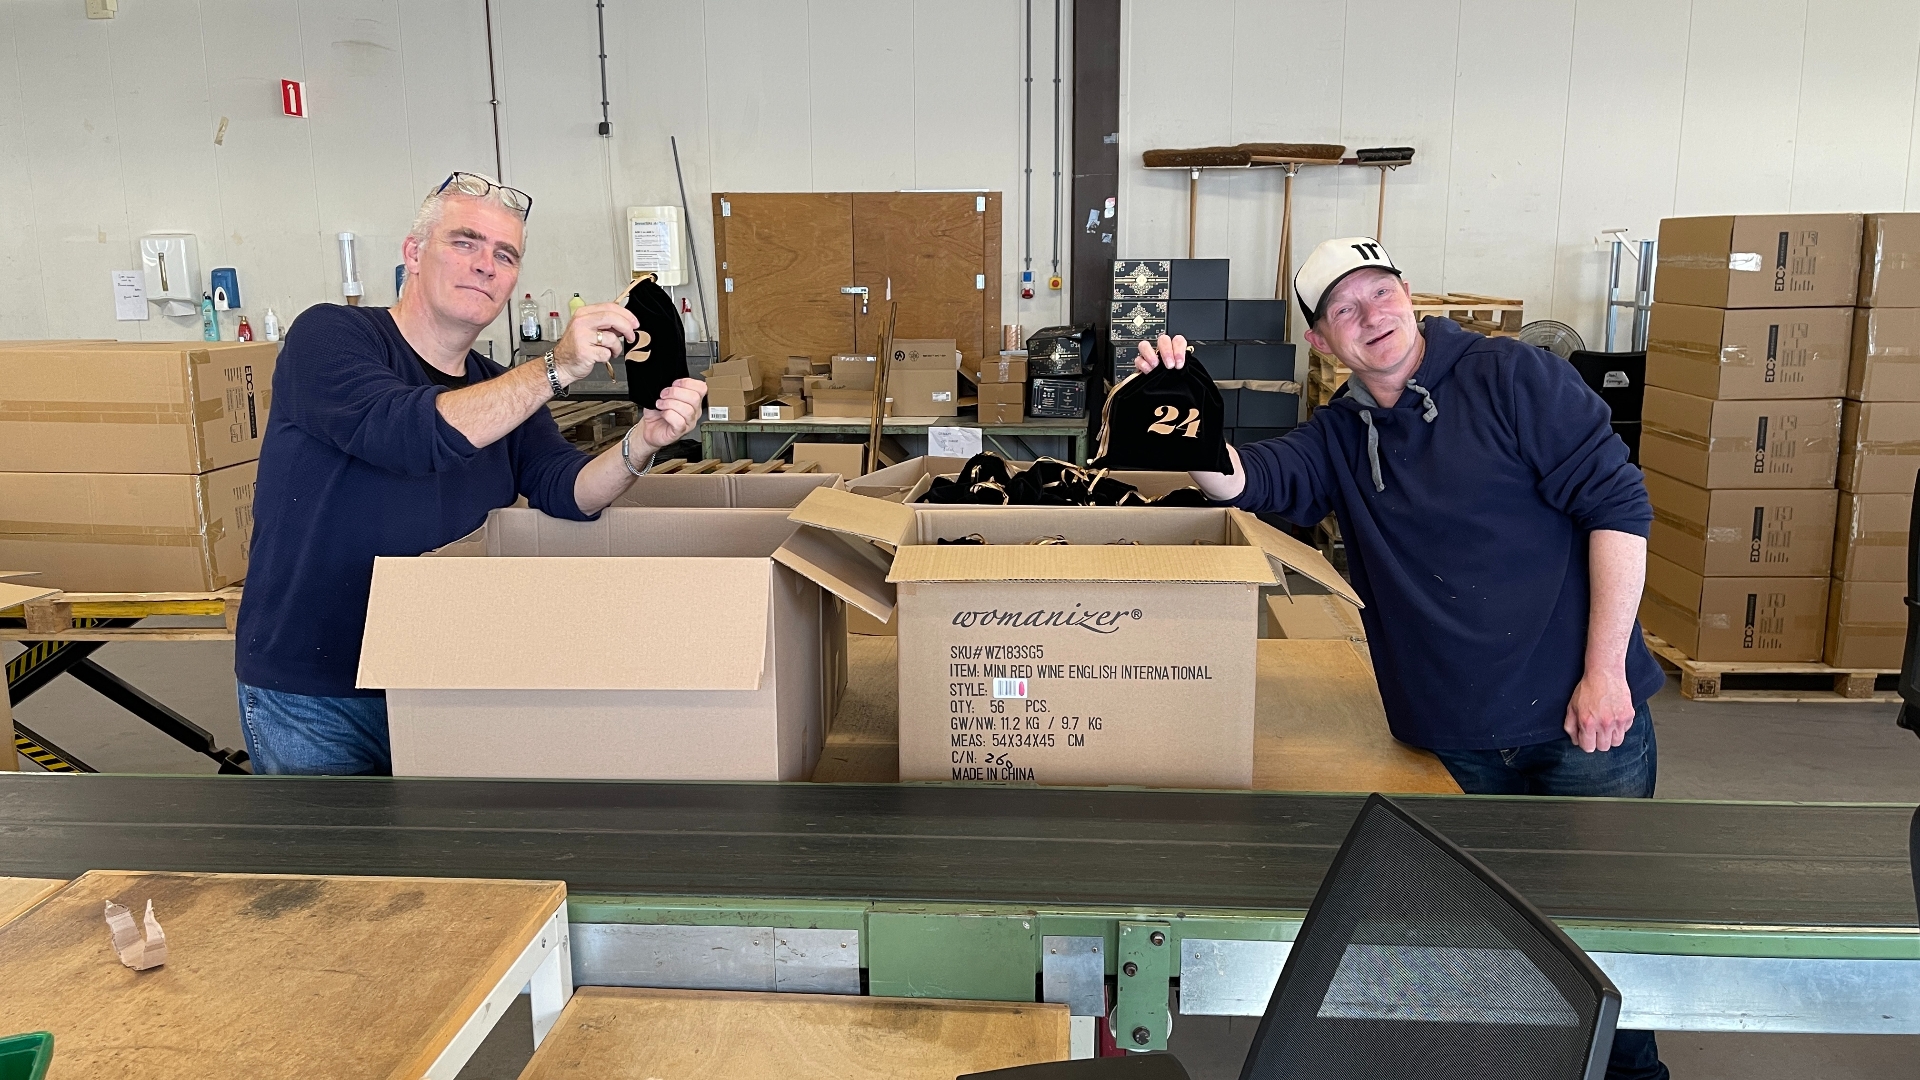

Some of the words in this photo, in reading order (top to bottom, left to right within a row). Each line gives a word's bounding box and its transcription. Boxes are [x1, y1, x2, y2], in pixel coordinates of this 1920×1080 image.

[1774, 270, 1785, 291] EDC
[245, 366, 254, 391] EDC
[1765, 362, 1775, 382] EDC
[1147, 405, 1200, 438] 24
[1754, 454, 1764, 473] EDC
[1750, 541, 1761, 562] EDC
[1743, 627, 1754, 649] EDC
[949, 663, 980, 677] ITEM:
[983, 663, 1007, 678] MINI
[1010, 664, 1033, 678] RED
[1037, 664, 1065, 679] WINE
[1068, 664, 1118, 679] ENGLISH
[1121, 664, 1213, 680] INTERNATIONAL
[949, 682, 988, 697] STYLE:
[950, 700, 975, 713] QTY:
[989, 699, 1005, 714] 56
[1025, 699, 1051, 713] PCS.
[950, 716, 996, 730] GW/NW:
[1000, 716, 1021, 730] 11.2
[1025, 716, 1040, 730] KG
[1061, 716, 1080, 730] 9.7
[1088, 716, 1103, 730] KG
[951, 733, 986, 747] MEAS:
[992, 733, 1055, 748] 54X34X45
[1067, 733, 1085, 747] CM
[951, 750, 977, 764] C/N:
[952, 767, 984, 781] MADE
[987, 767, 998, 781] IN
[1001, 767, 1035, 781] CHINA
